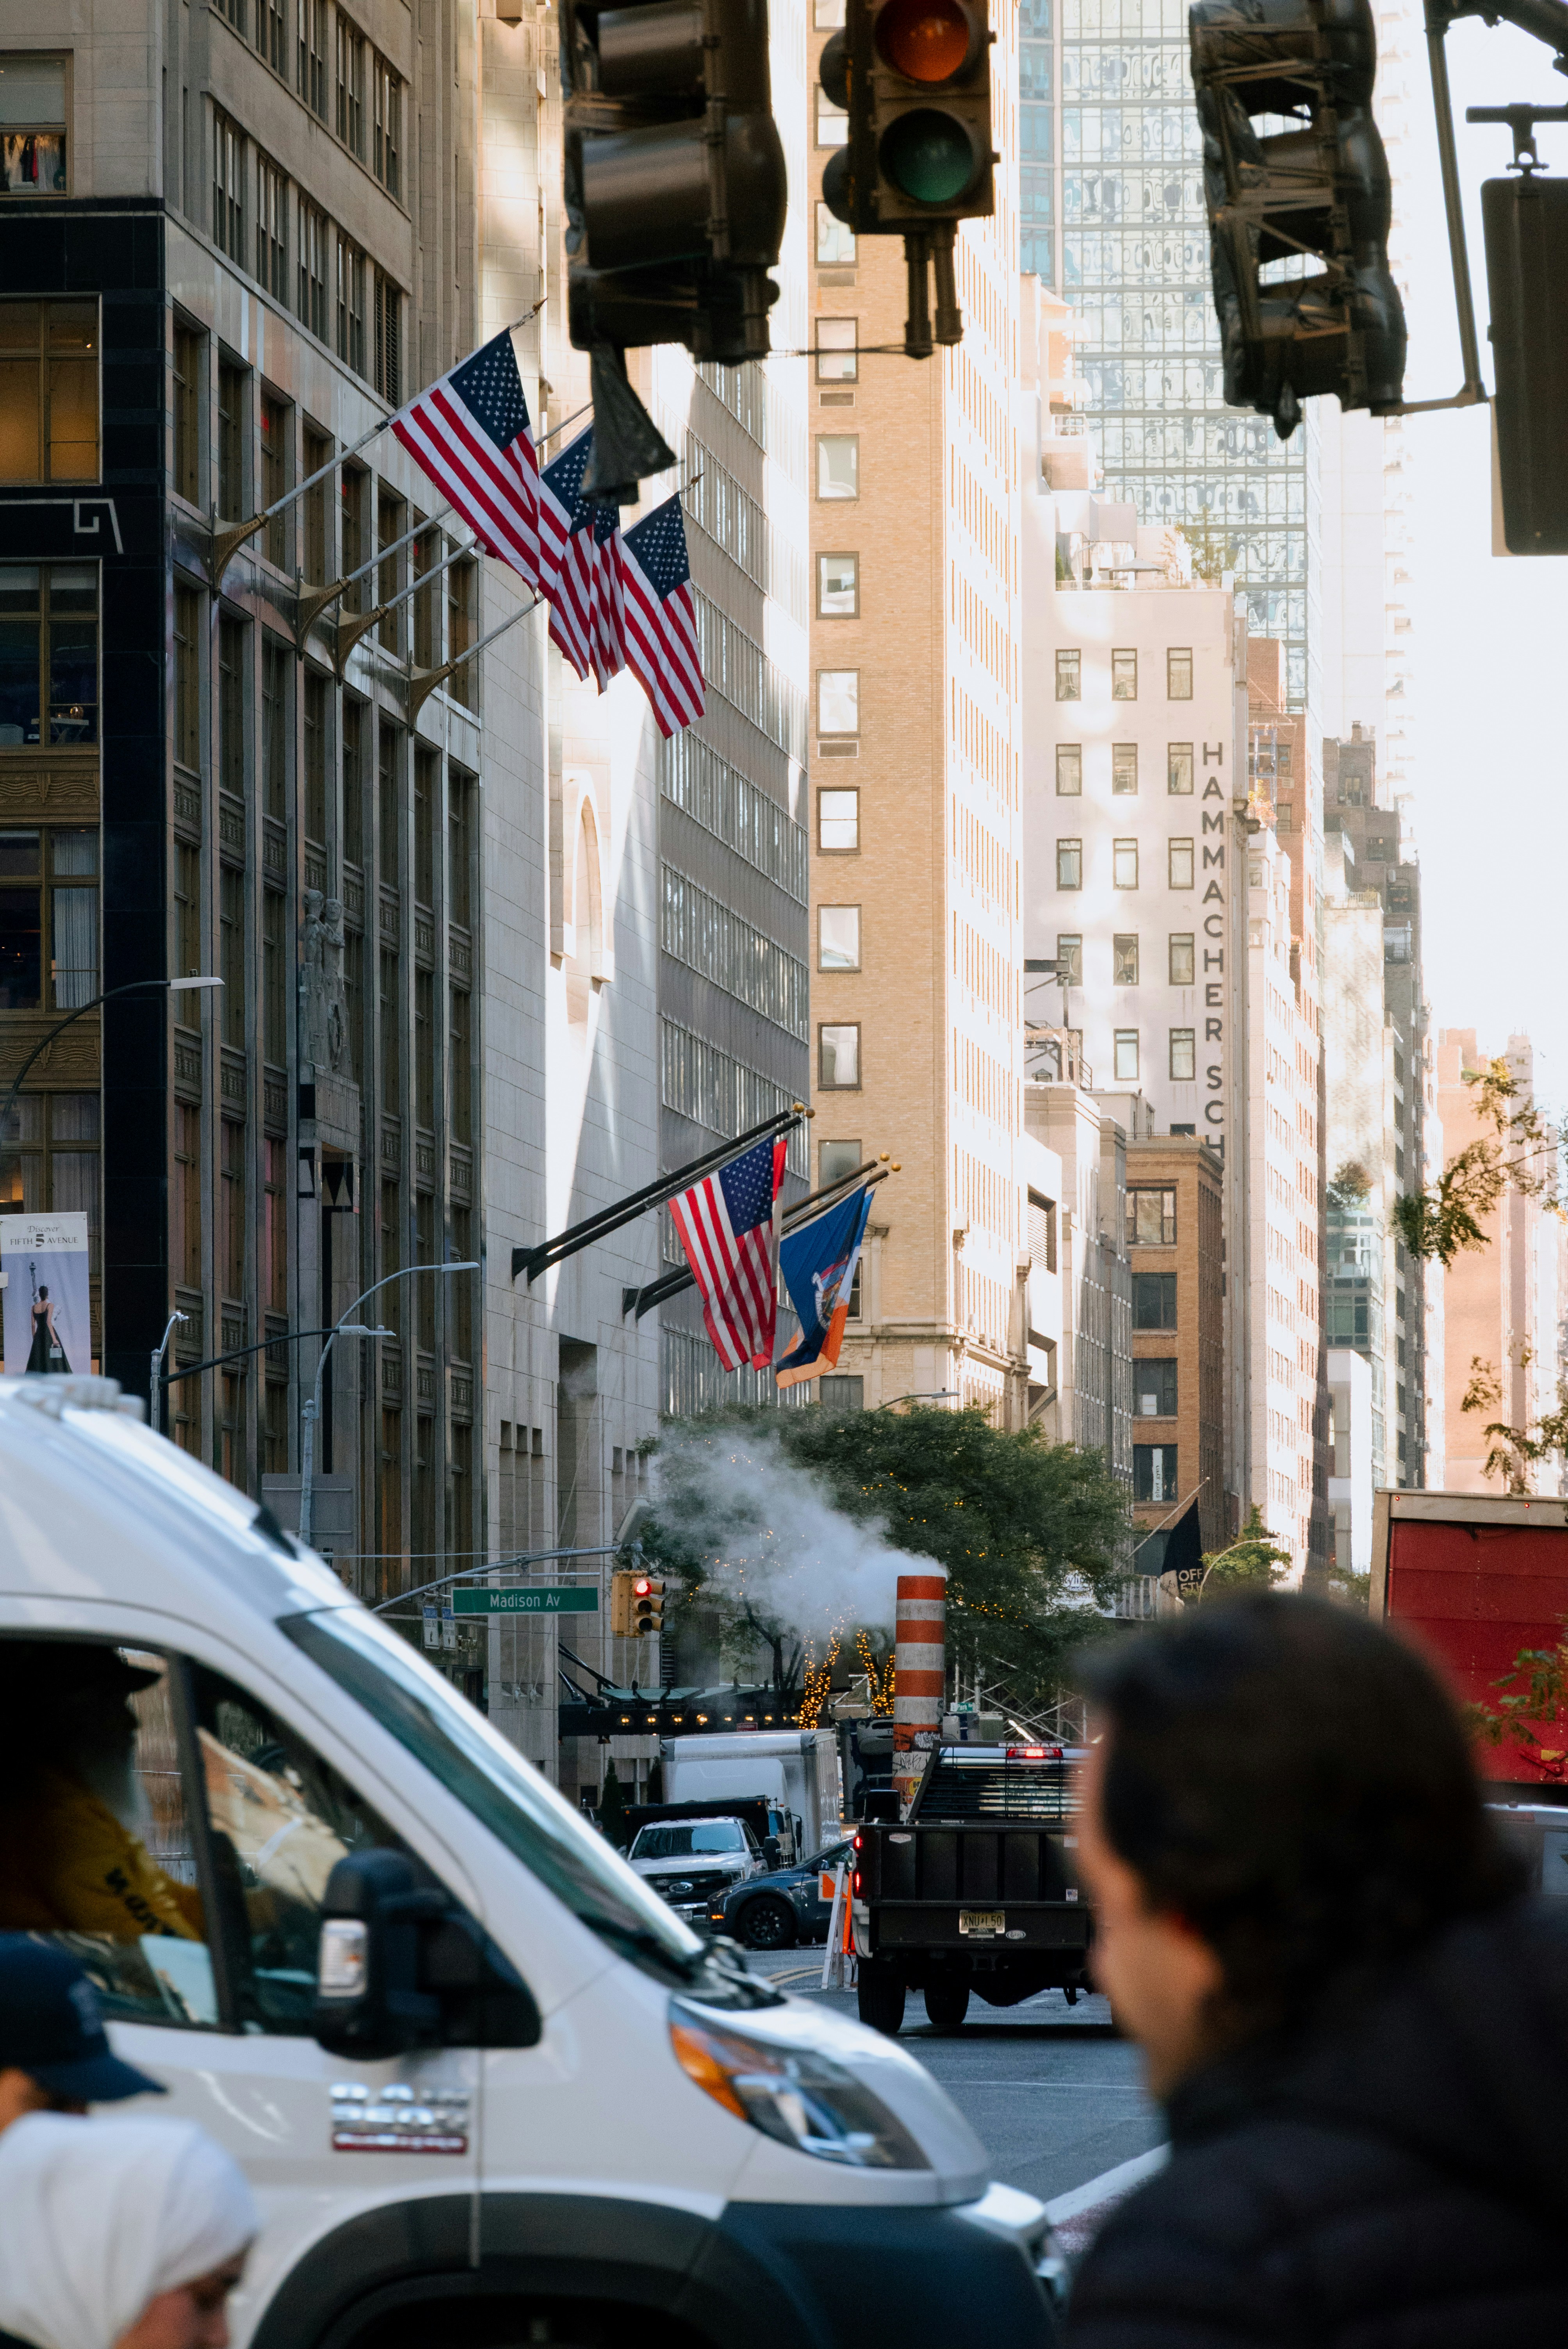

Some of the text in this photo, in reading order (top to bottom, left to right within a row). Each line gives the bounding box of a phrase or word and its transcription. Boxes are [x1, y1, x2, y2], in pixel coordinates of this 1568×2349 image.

[1202, 742, 1224, 1041] HAMMACHER
[36, 1234, 45, 1248] 5
[1179, 1568, 1203, 1582] OFF
[490, 1593, 560, 1608] Madison Av
[964, 1916, 980, 1927] XNU
